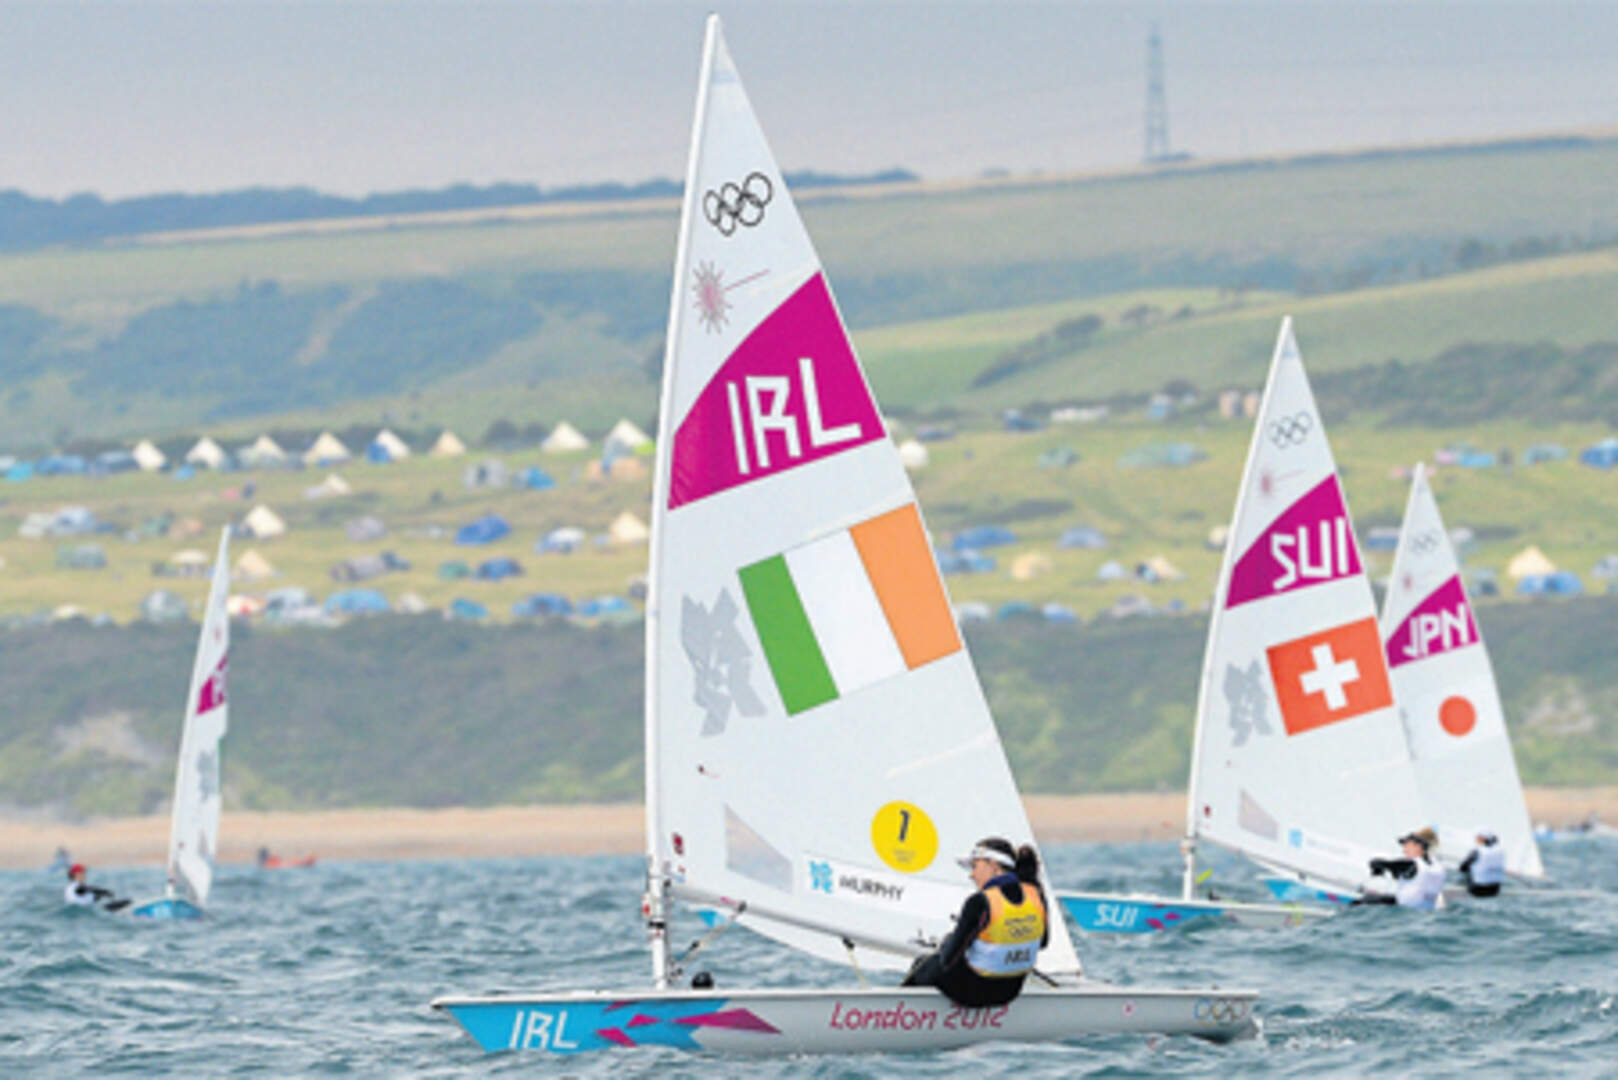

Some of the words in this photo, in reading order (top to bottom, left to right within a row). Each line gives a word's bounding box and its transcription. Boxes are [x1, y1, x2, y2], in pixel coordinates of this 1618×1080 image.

[727, 357, 863, 475] IRL
[1271, 516, 1349, 591] SUI
[1402, 602, 1468, 657] JPN
[839, 874, 904, 901] MURPHY
[1093, 903, 1139, 928] SUI
[509, 1010, 581, 1050] IRL
[829, 1001, 937, 1030] London
